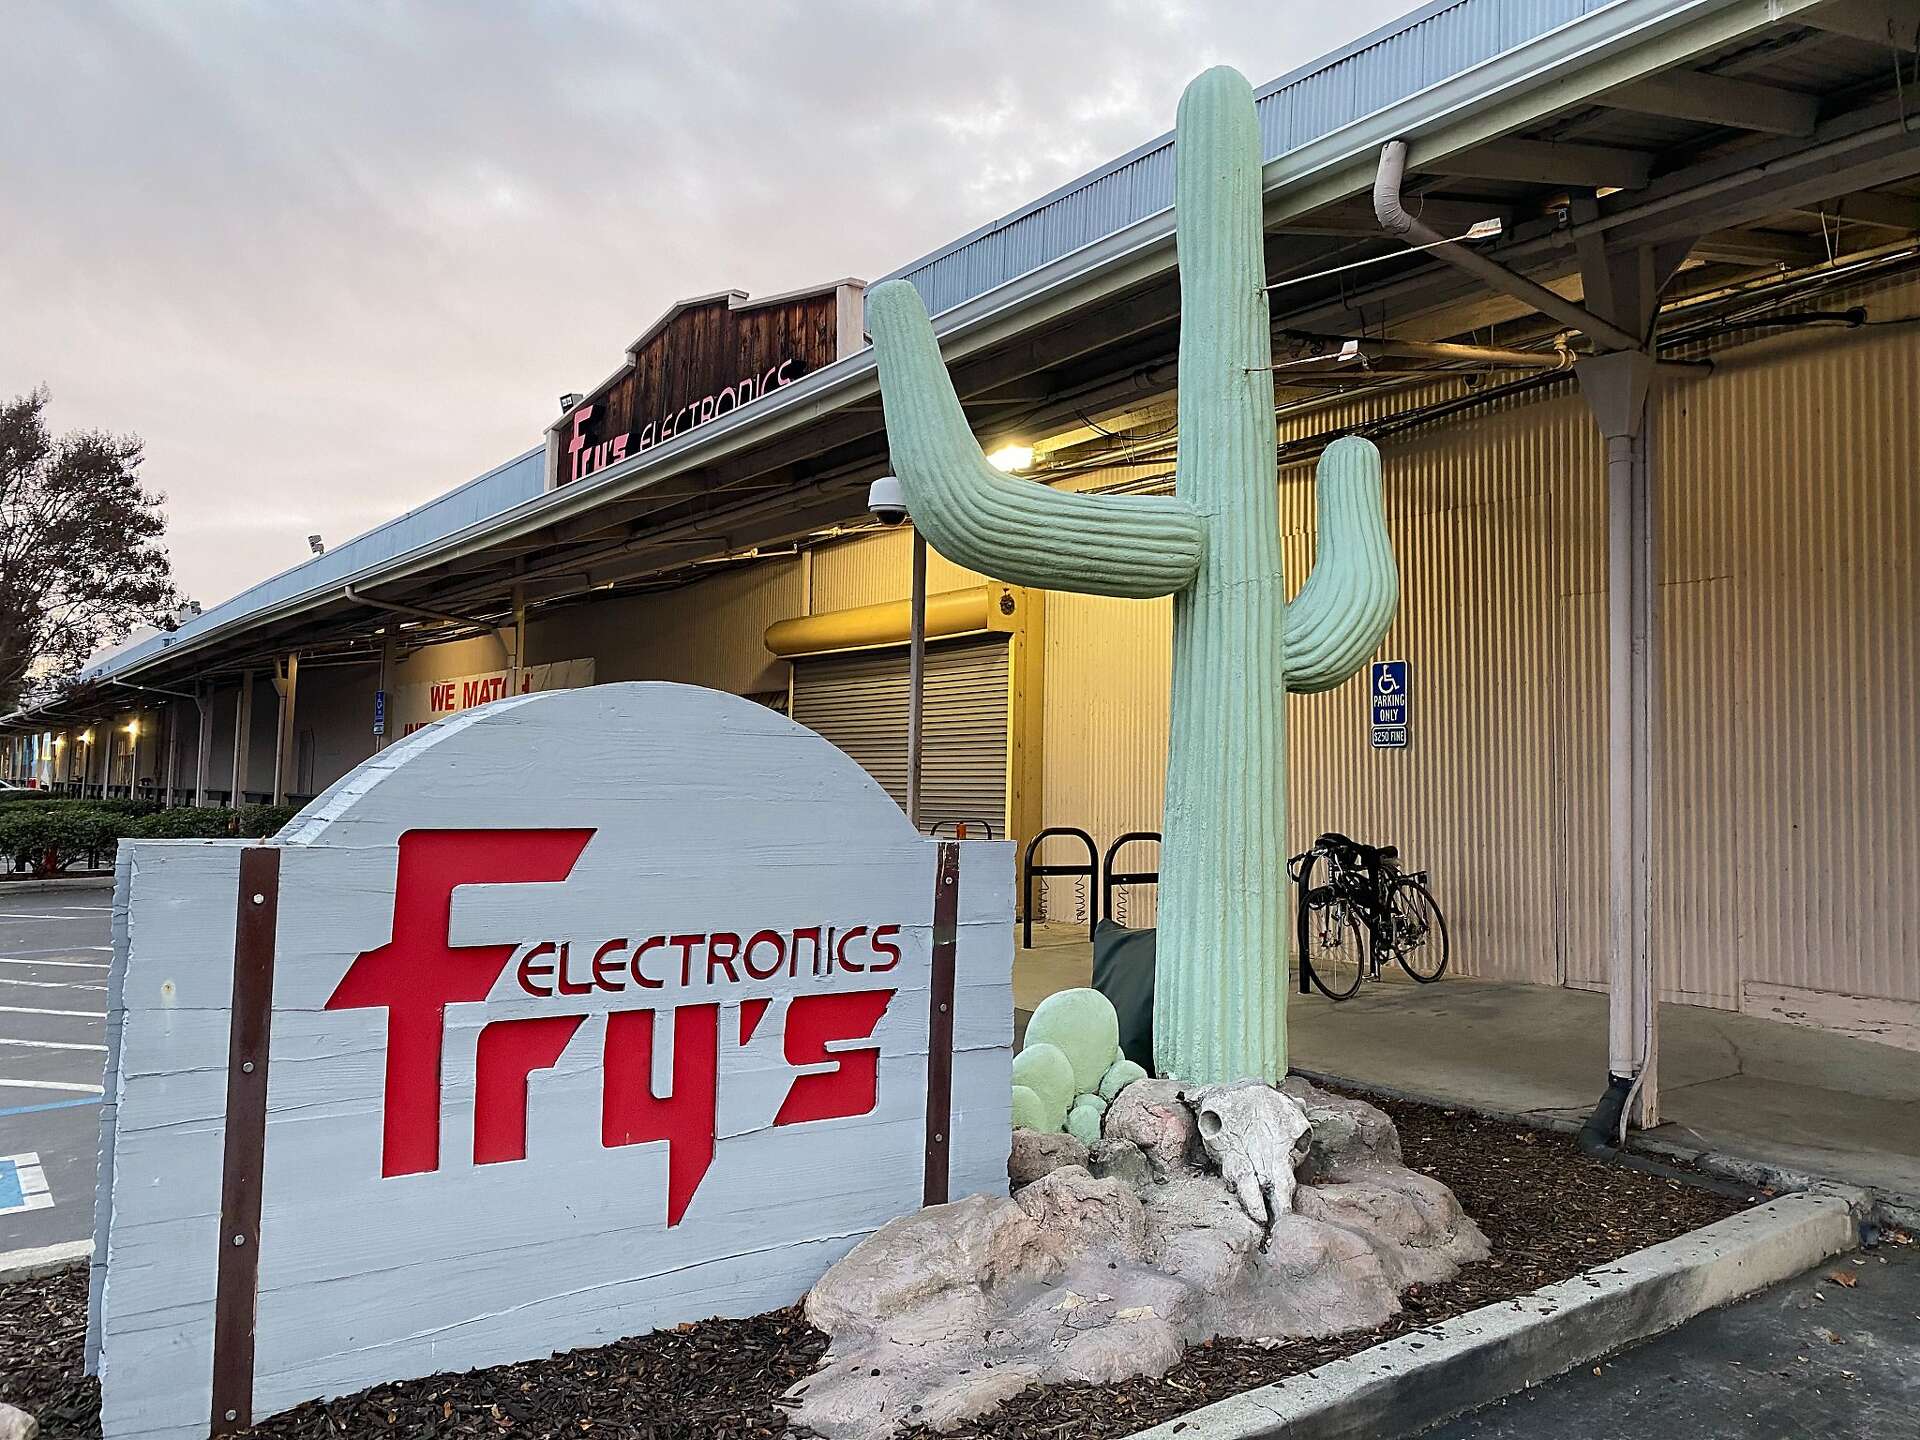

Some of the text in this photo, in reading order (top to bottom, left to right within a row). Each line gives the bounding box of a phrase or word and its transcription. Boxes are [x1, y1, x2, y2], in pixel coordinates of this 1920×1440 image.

[640, 358, 791, 451] ELECTRONICS
[430, 683, 456, 712] WE
[1373, 693, 1405, 708] PARKING
[1380, 708, 1399, 722] ONLY
[1374, 730, 1404, 742] $250 FINE
[516, 924, 901, 997] ELECTRONICS
[325, 828, 898, 1228] Fry's
